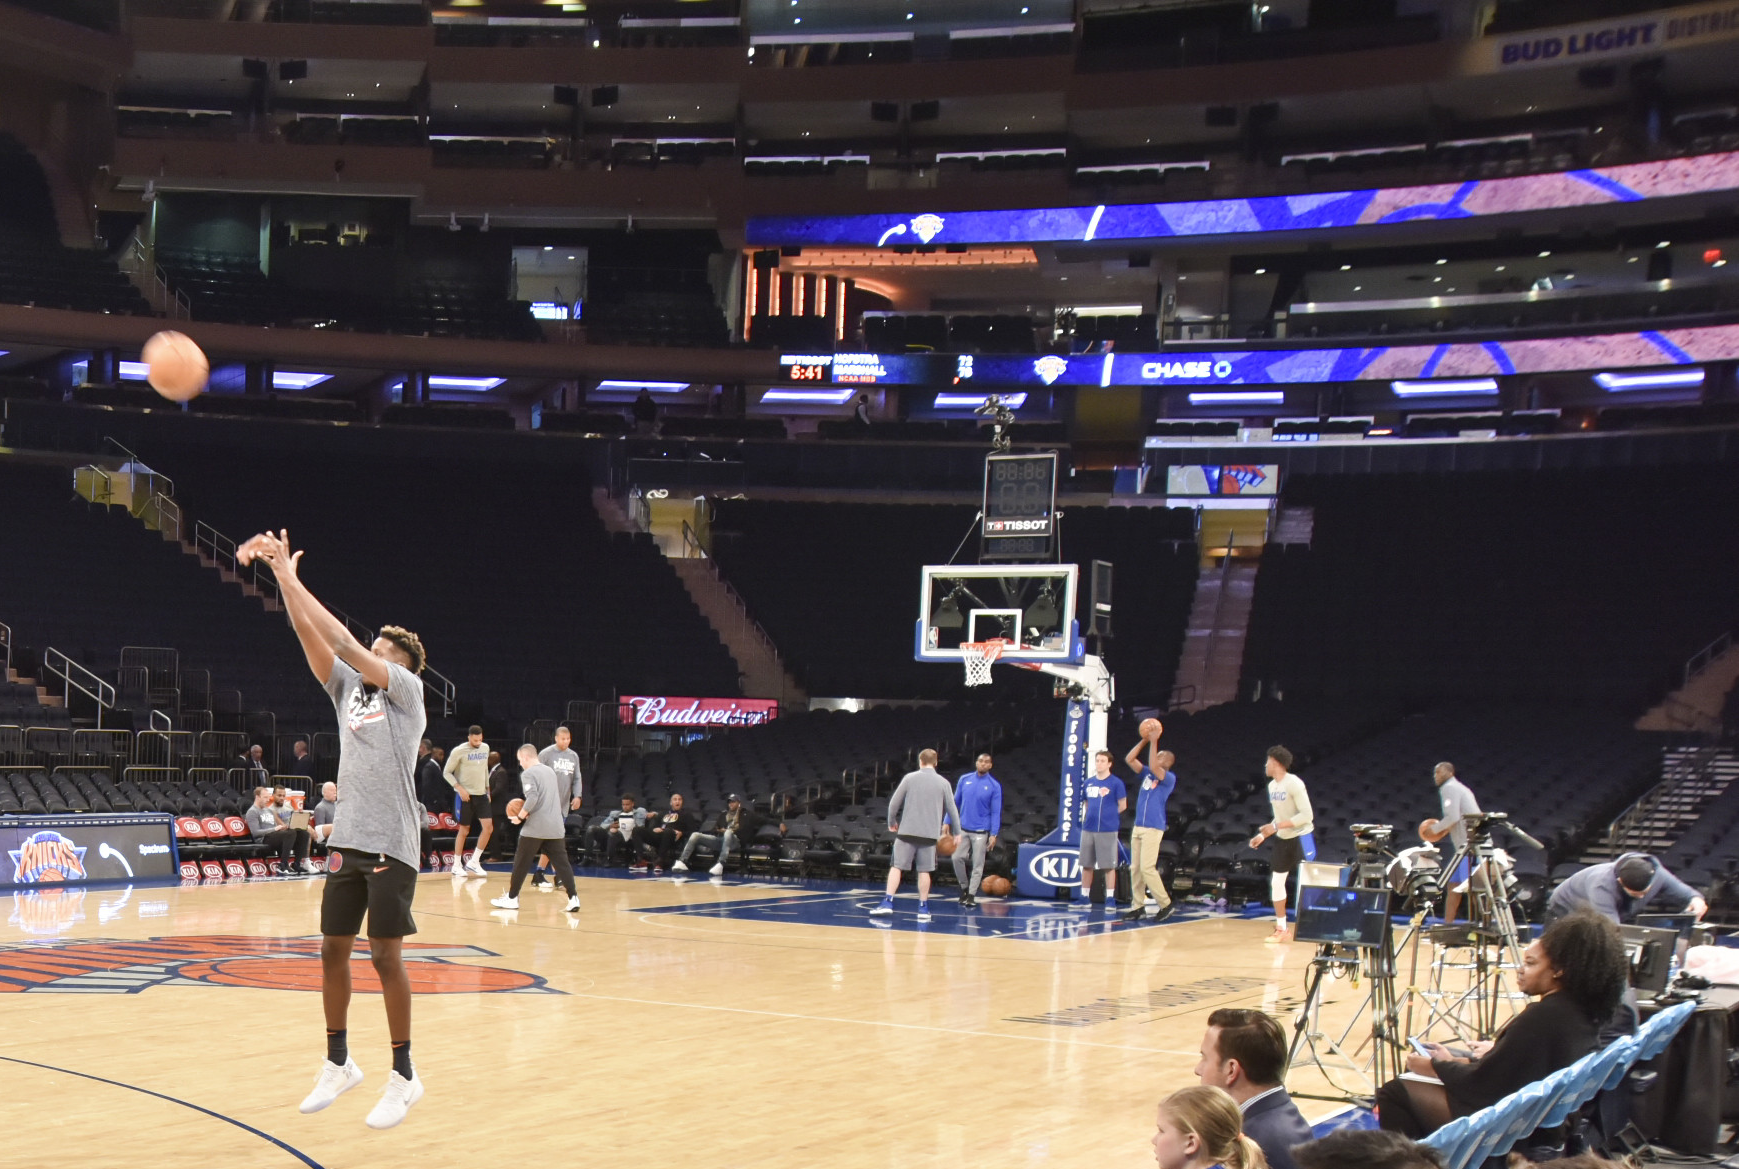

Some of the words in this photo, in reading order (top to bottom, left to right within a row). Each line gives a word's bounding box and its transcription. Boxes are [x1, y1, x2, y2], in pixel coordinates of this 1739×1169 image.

[1502, 37, 1564, 64] BUD
[1567, 22, 1658, 55] LIGHT
[790, 365, 823, 380] 5:41
[1142, 362, 1211, 379] CHASE
[1004, 520, 1048, 530] TISSOT
[1067, 721, 1079, 767] Foot
[467, 752, 488, 761] MAGIC
[1062, 773, 1074, 842] Locker
[138, 844, 169, 856] Spectrum
[20, 841, 83, 877] KNICKS
